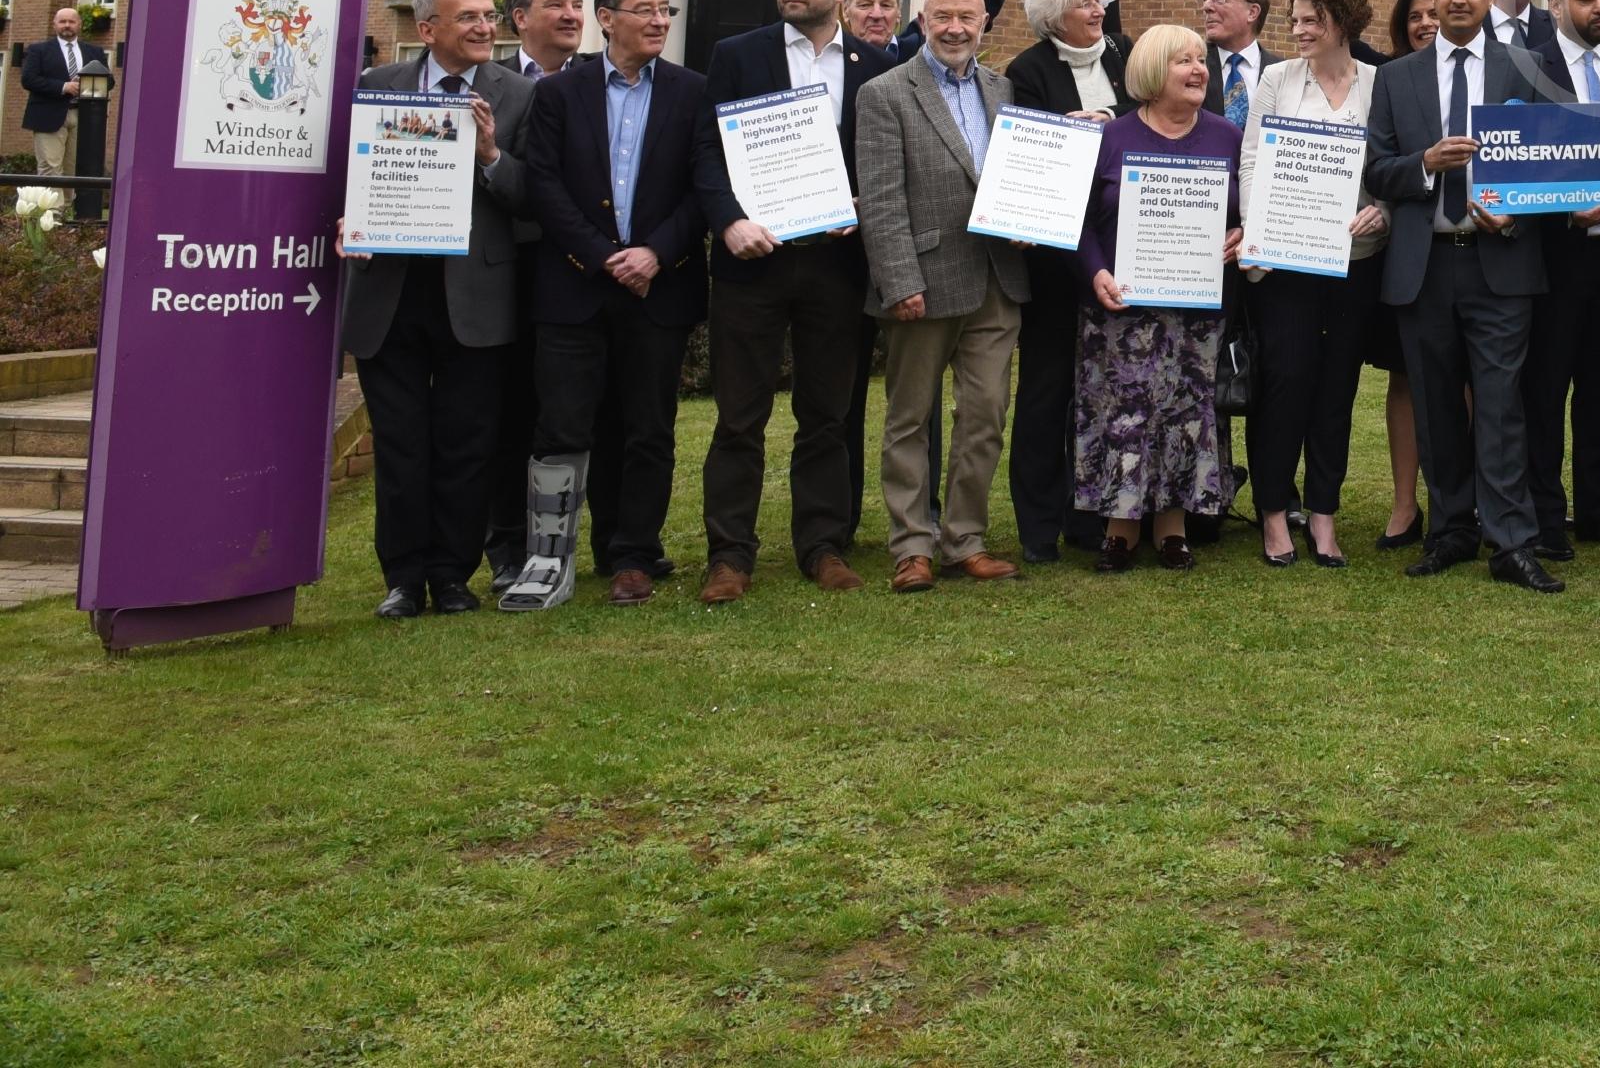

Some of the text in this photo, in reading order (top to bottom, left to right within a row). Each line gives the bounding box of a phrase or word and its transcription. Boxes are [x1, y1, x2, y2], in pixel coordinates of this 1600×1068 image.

[740, 105, 818, 128] Investing in our
[216, 121, 308, 140] Windsor &
[743, 116, 814, 139] highways and
[1014, 123, 1068, 140] Protect the
[746, 132, 802, 152] pavements
[1012, 135, 1063, 150] vulnerable
[1479, 130, 1520, 144] VOTE
[204, 138, 312, 159] Maidenhead
[373, 145, 438, 157] State of the
[372, 159, 456, 170] art new leisure
[371, 171, 419, 182] facilities
[1142, 173, 1169, 183] 7,500
[1194, 177, 1225, 186] school
[1141, 185, 1210, 197] places at Good
[1140, 197, 1219, 211] and Outstanding
[1139, 208, 1175, 218] schools
[158, 234, 325, 269] Town Hall
[151, 288, 283, 316] Reception
